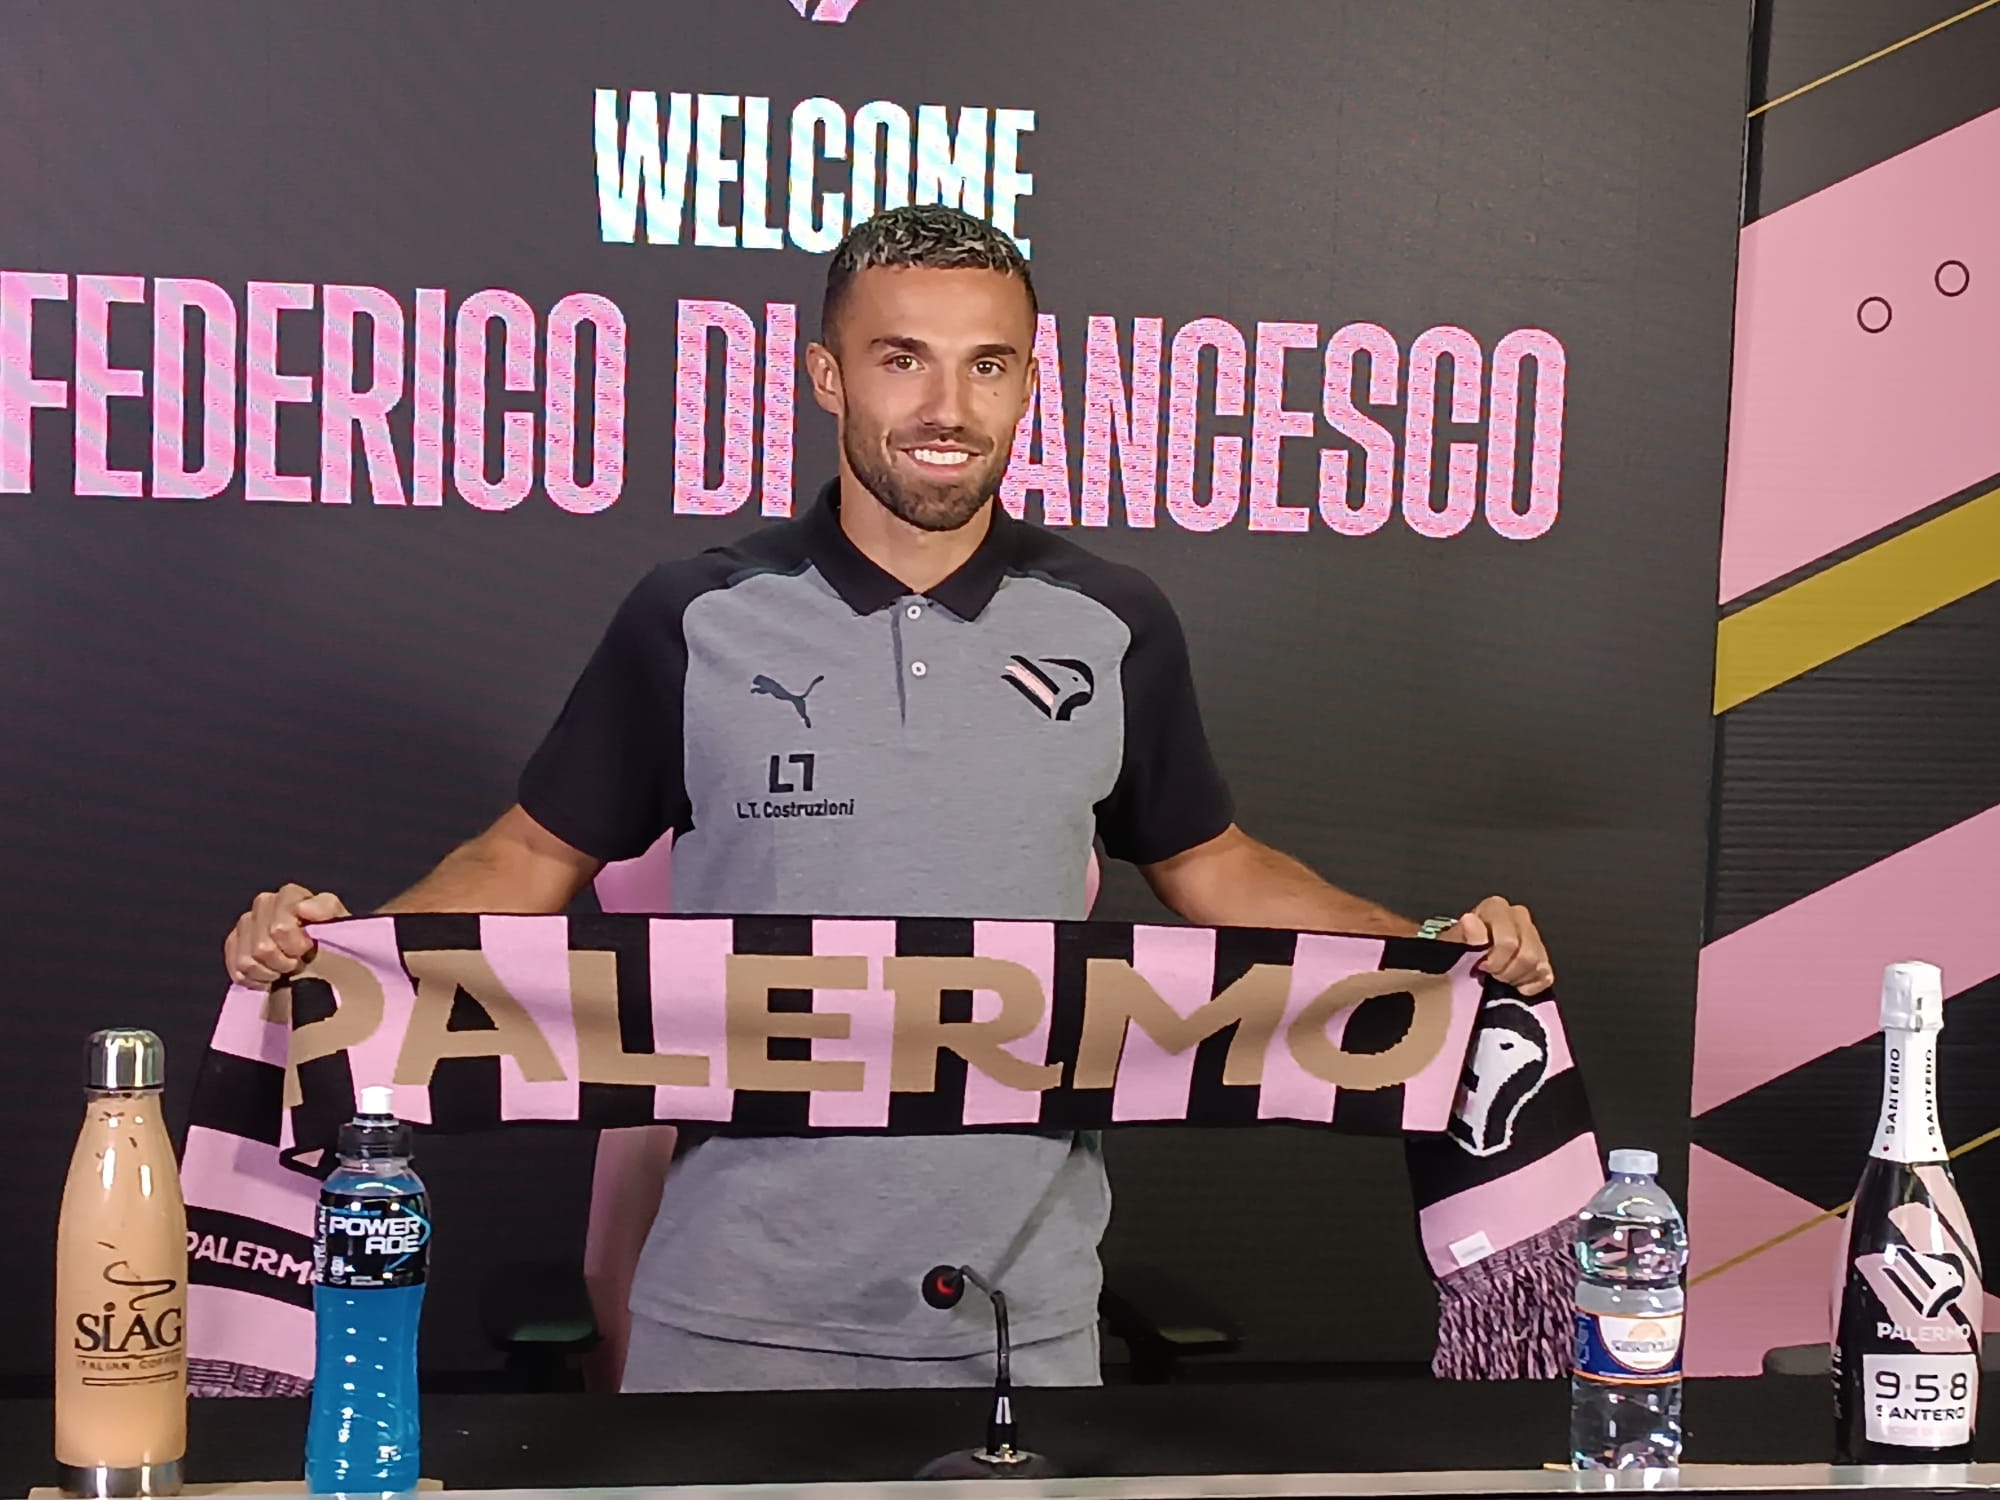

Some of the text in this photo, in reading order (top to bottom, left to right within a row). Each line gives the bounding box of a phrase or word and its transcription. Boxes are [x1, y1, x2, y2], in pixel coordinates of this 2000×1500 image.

[594, 87, 1036, 261] WELCOME
[0, 270, 1567, 541] FEDERICO DI ANCESCO
[763, 798, 855, 818] Costruzioni
[262, 947, 1453, 1108] PALERMO
[329, 1216, 421, 1236] POWER
[365, 1234, 420, 1255] ADE
[1876, 1321, 1972, 1343] PALERMO
[1875, 1404, 1966, 1422] SANTERO
